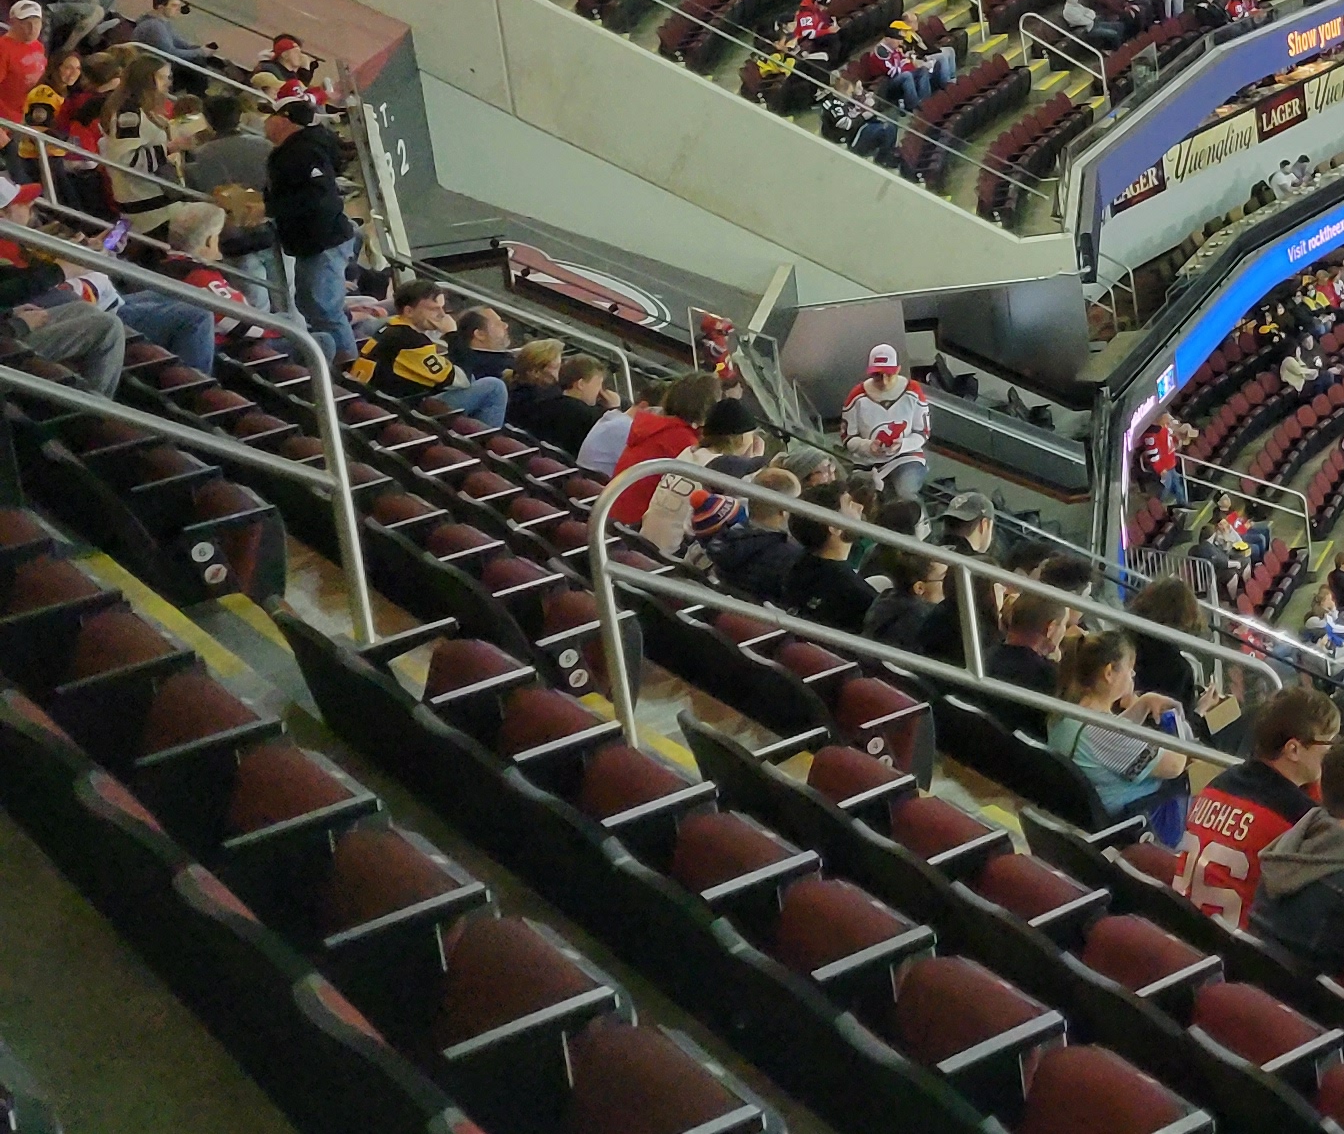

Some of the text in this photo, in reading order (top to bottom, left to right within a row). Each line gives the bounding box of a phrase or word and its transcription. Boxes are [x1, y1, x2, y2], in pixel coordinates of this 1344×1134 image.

[1288, 29, 1316, 57] Show
[1317, 17, 1341, 47] your
[1166, 98, 1302, 183] Yuengling LAGER
[1288, 242, 1307, 263] Visit
[423, 354, 443, 375] 8
[1189, 796, 1255, 841] HUGHES
